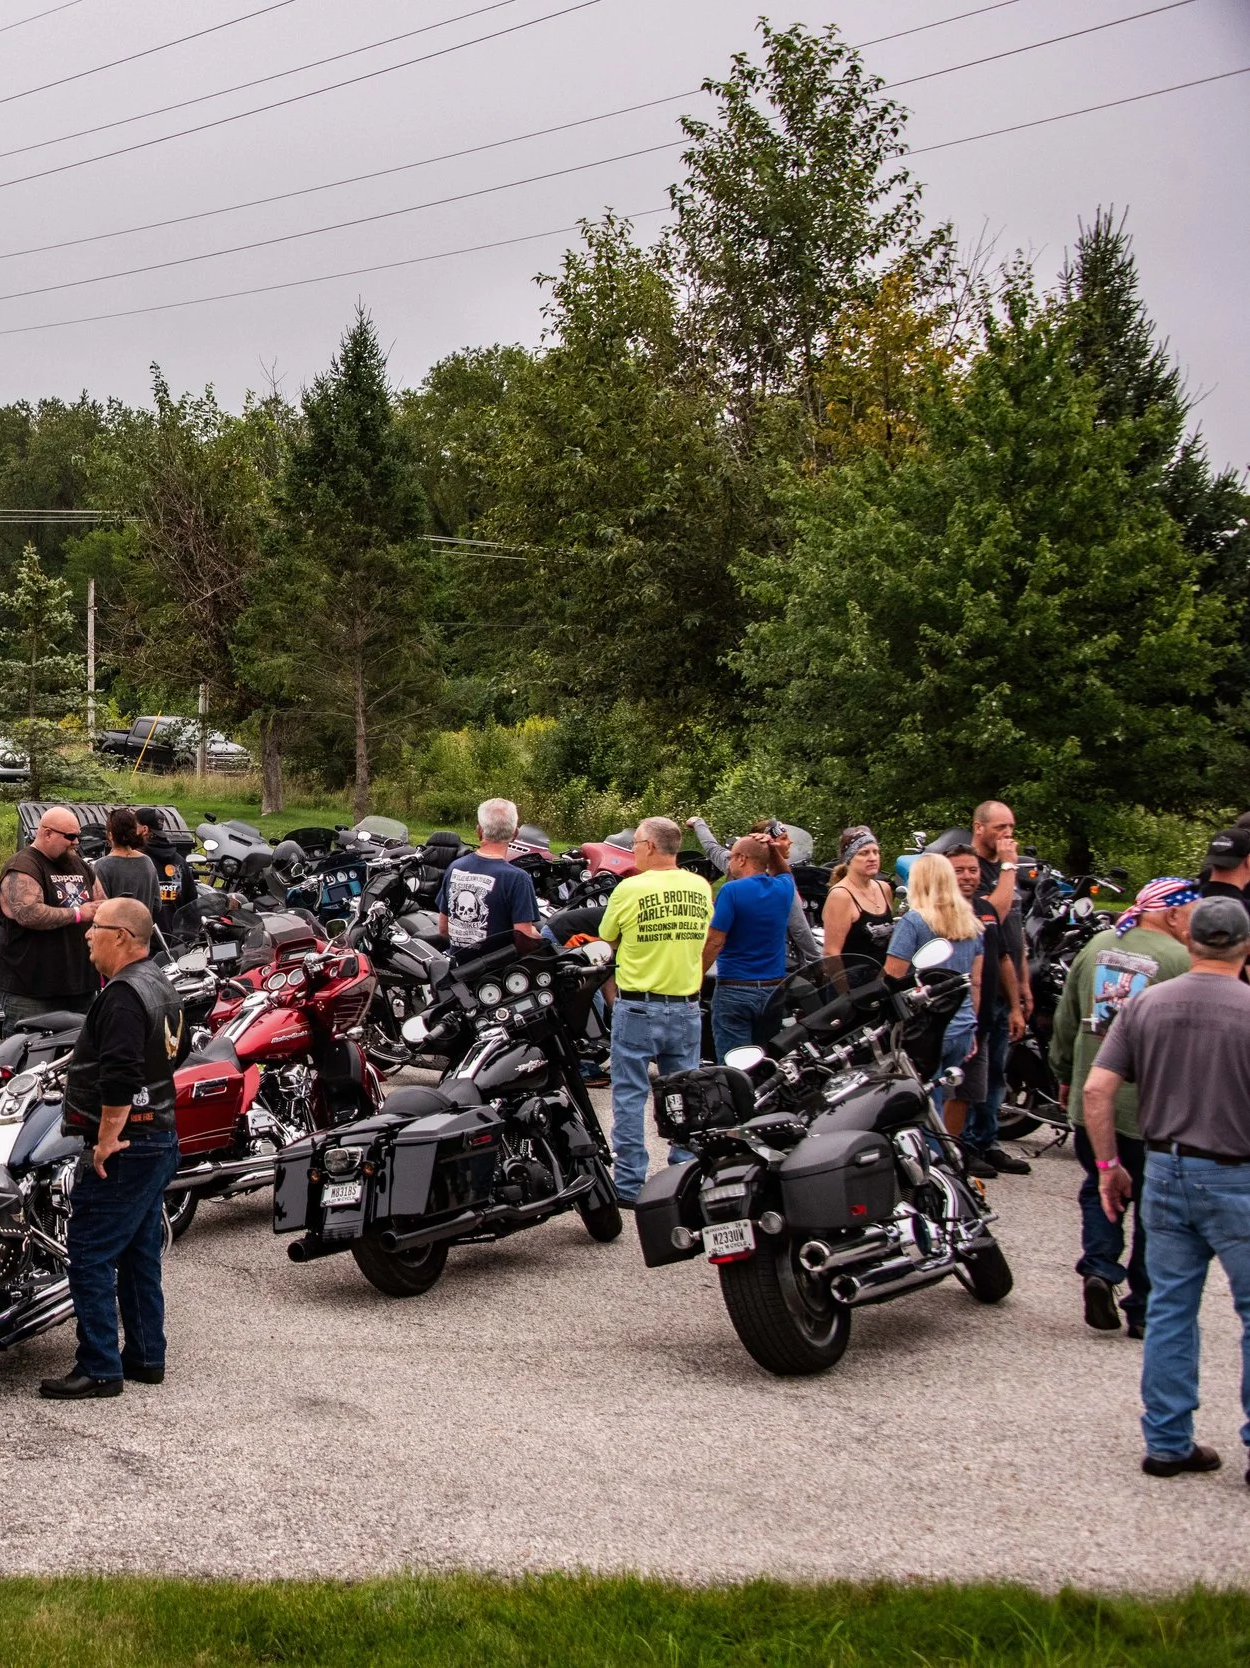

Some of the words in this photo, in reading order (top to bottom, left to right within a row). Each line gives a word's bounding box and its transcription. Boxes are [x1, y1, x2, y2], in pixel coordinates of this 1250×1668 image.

[51, 875, 84, 883] SUPPORT
[638, 893, 661, 911] REEL
[663, 890, 707, 908] BROTHERS
[637, 904, 708, 924] HARLEY-DAVIDSON
[639, 922, 677, 932] WISCONSIN
[331, 1185, 357, 1198] M831BS
[713, 1229, 744, 1245] M233UW
